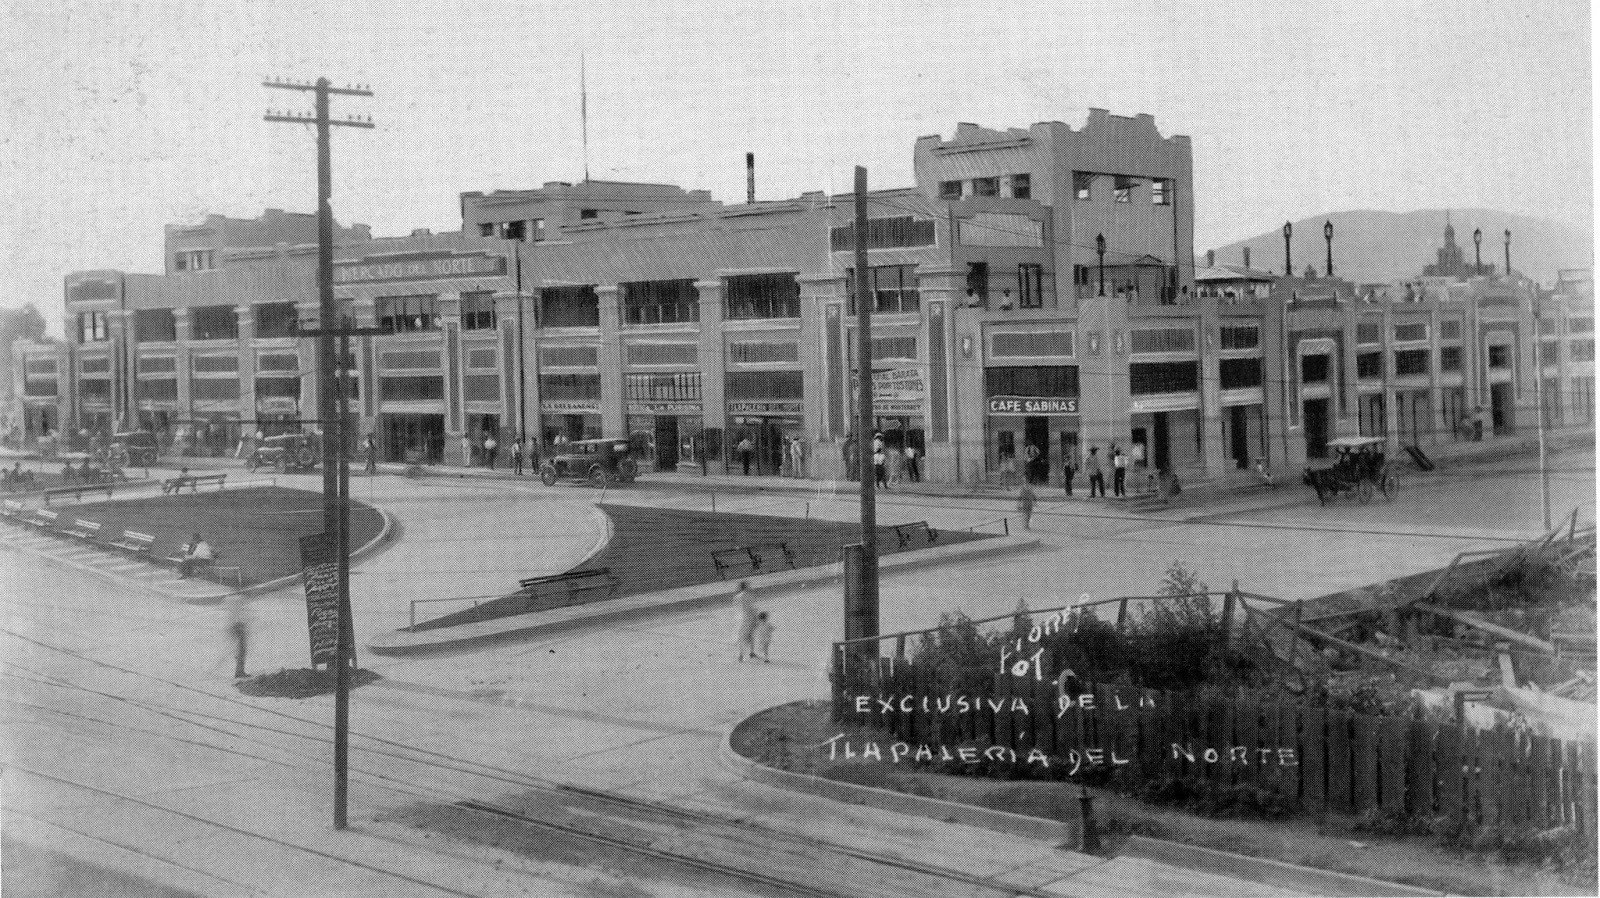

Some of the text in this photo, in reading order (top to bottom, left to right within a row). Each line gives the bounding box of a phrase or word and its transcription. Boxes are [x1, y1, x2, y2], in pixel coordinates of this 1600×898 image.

[341, 263, 403, 281] MERCADO
[433, 257, 475, 275] NORTE
[990, 400, 1076, 412] CAFE SABINAS
